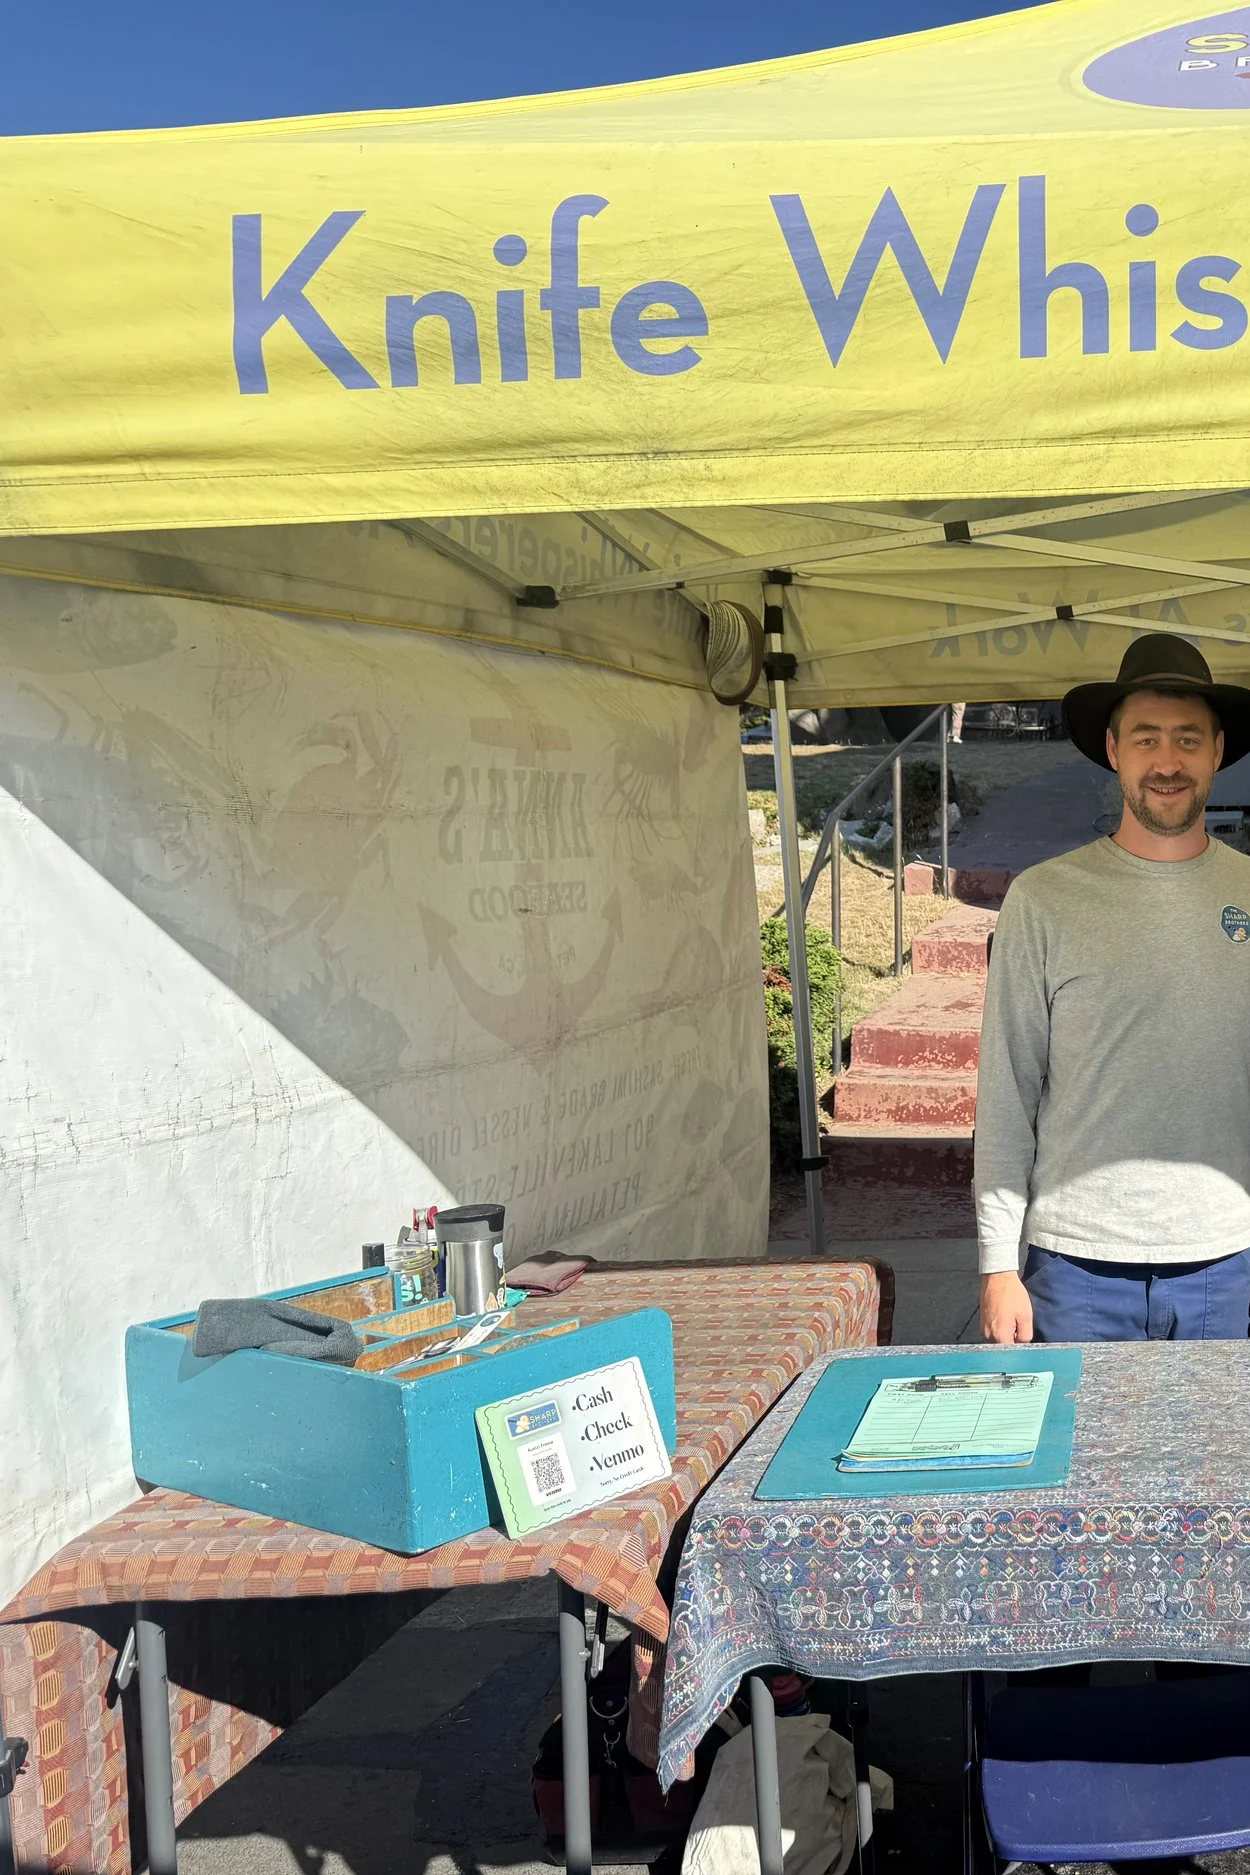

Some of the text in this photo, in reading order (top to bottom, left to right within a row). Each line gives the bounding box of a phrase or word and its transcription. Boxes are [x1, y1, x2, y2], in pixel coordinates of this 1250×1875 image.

[231, 194, 710, 395] Knife
[1224, 912, 1247, 920] SHARP
[529, 1408, 557, 1424] SHARP
